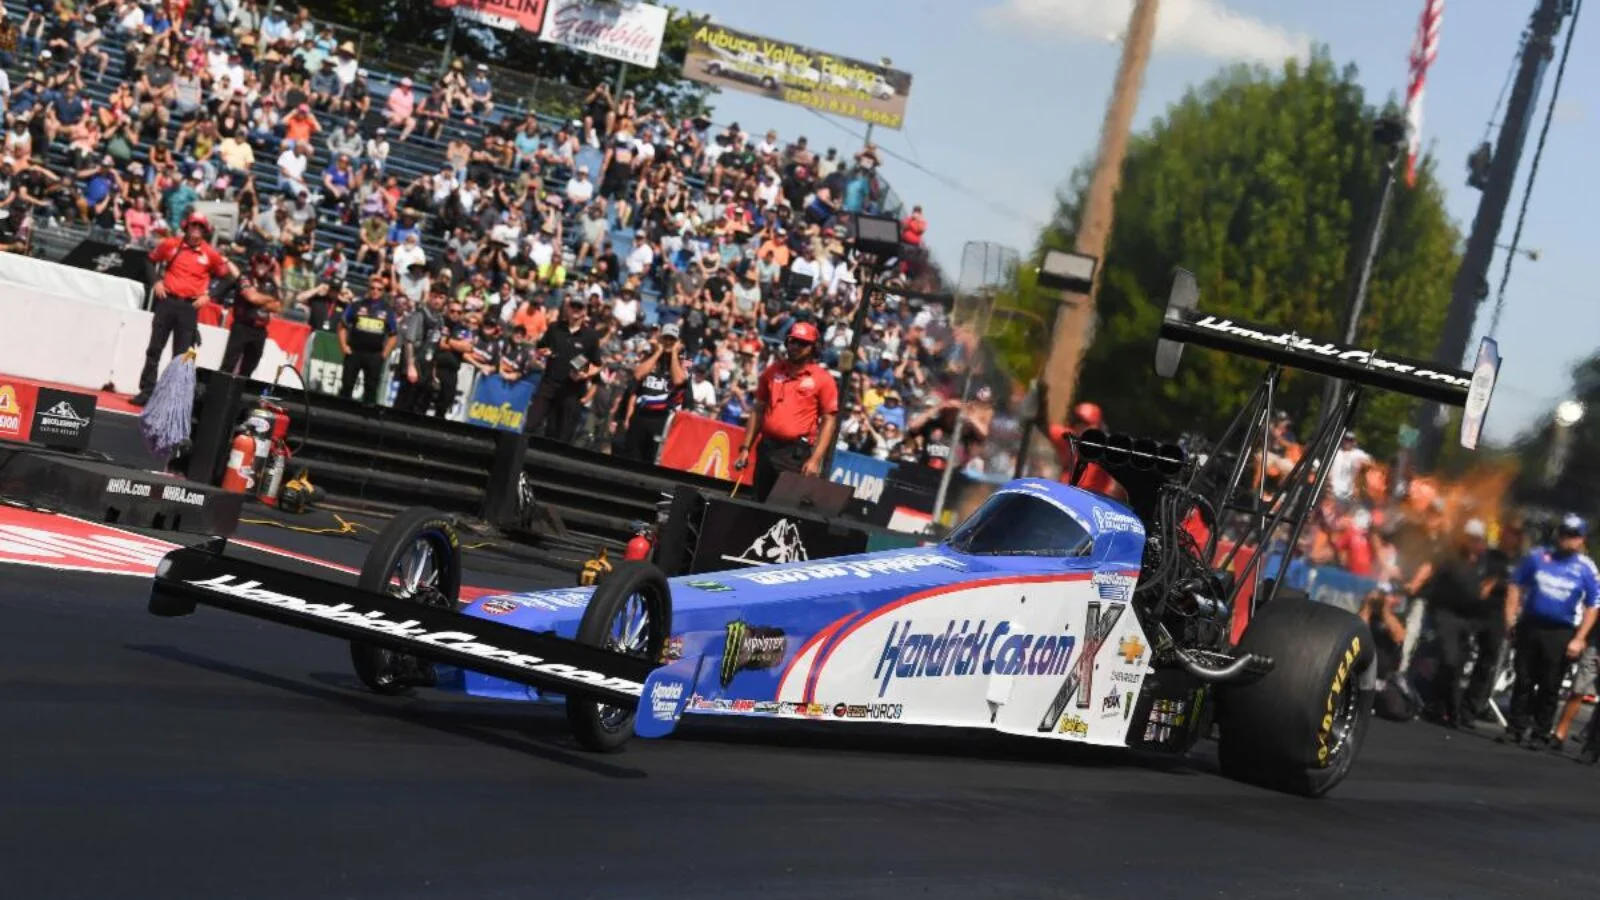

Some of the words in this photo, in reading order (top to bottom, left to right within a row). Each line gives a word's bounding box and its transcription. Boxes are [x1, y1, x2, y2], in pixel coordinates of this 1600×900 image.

[554, 4, 656, 51] Gamblin
[694, 25, 758, 53] Auburn
[762, 40, 813, 70] Valley
[106, 477, 152, 498] NHRA.com
[162, 485, 205, 507] NHRA.com
[743, 635, 785, 653] MONSTER
[873, 619, 1076, 698] HendrickCars.com
[1102, 694, 1121, 712] PEAK
